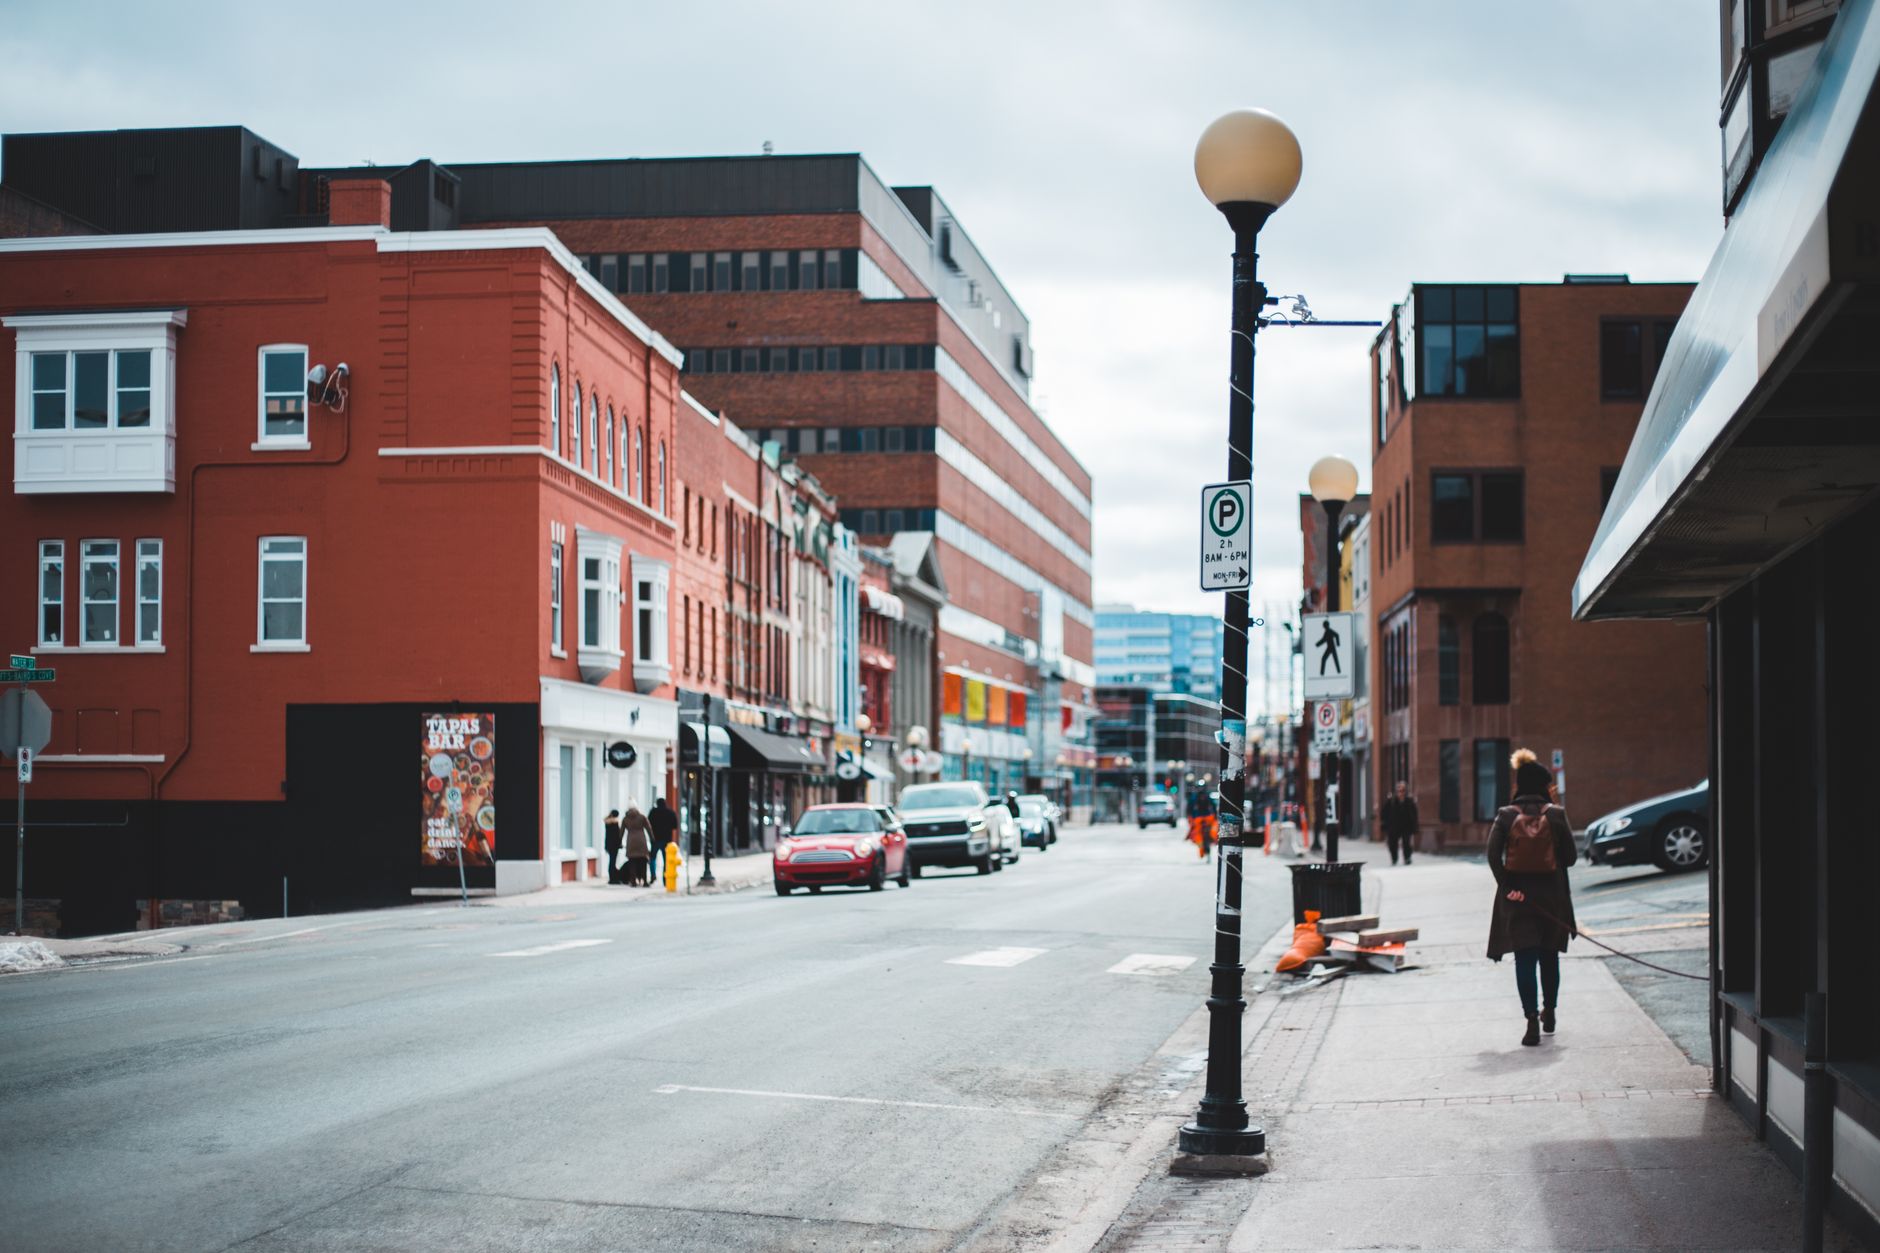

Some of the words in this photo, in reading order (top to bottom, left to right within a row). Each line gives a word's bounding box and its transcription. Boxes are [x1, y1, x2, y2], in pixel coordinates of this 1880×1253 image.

[1219, 499, 1236, 527] P
[1220, 540, 1225, 549] 2
[1228, 539, 1233, 548] h
[1205, 553, 1222, 563] 8AM
[1230, 551, 1247, 561] 6PM
[38, 671, 53, 680] COVE
[426, 718, 480, 735] TAPAS
[428, 734, 466, 750] BAR
